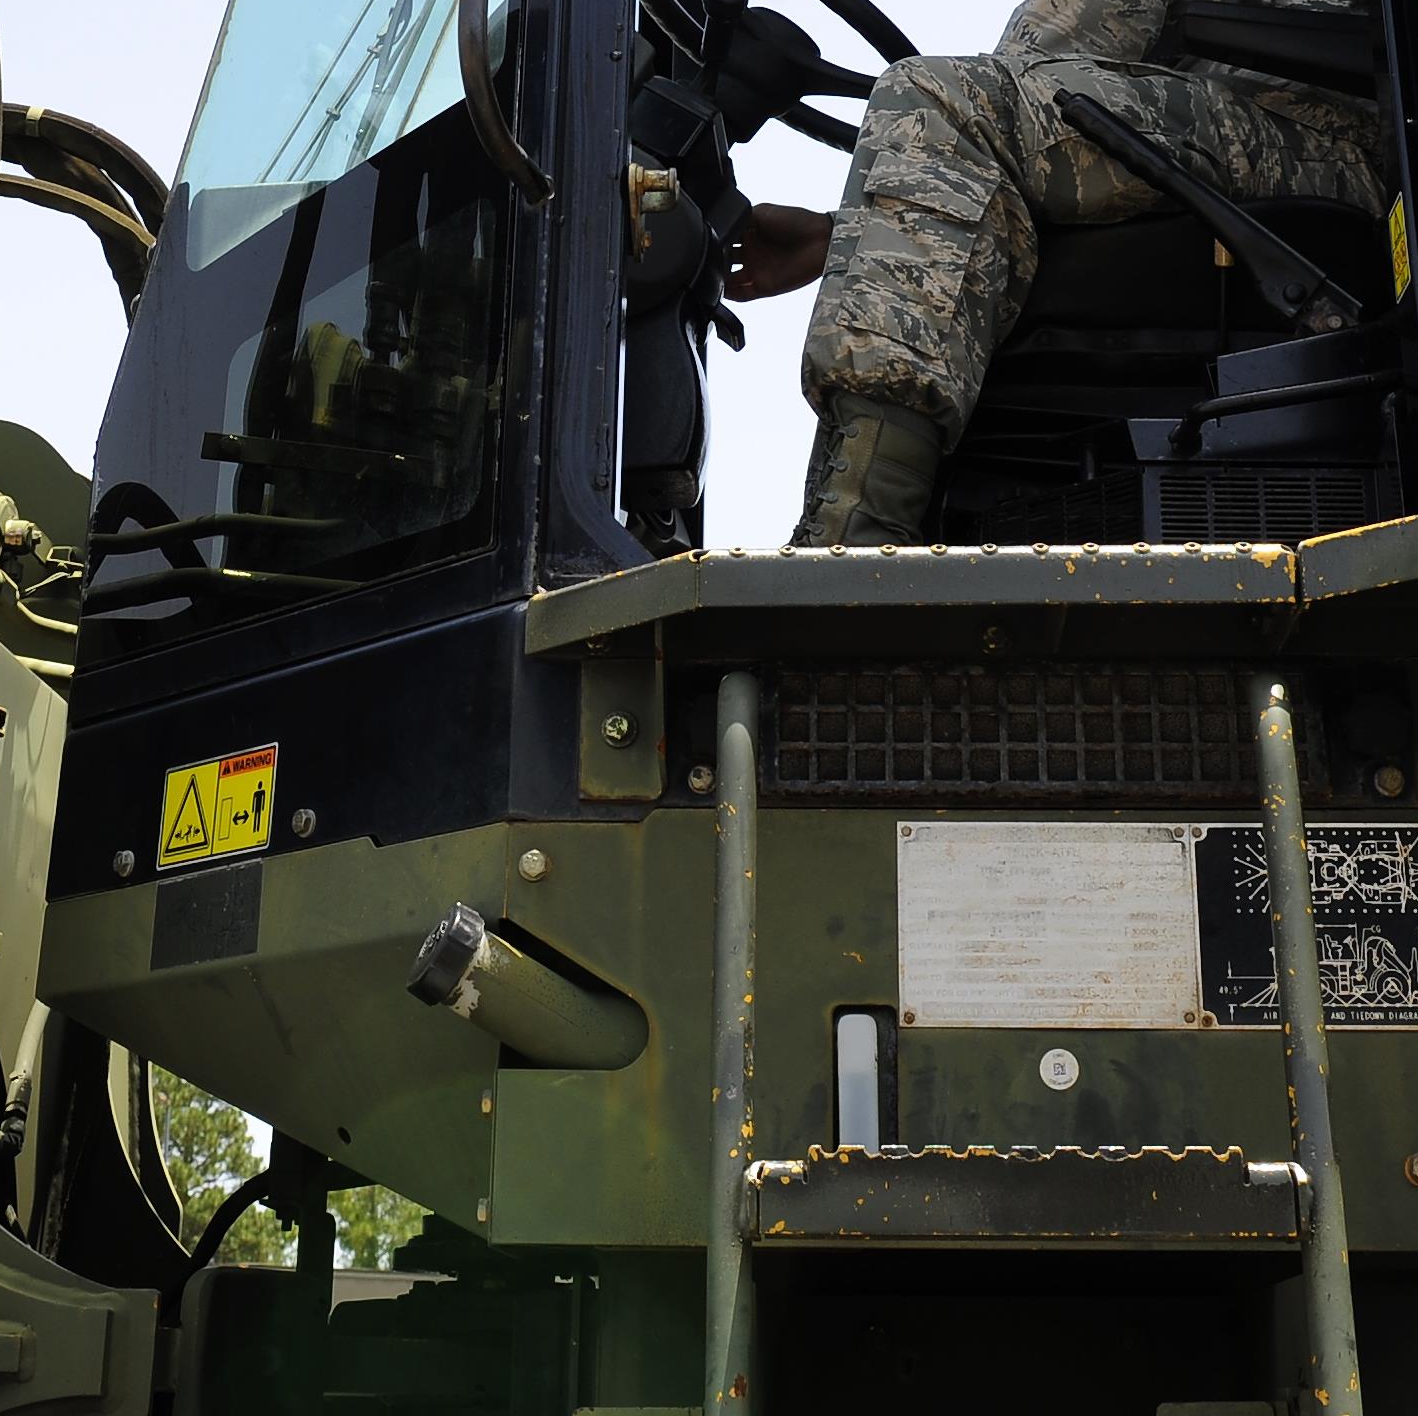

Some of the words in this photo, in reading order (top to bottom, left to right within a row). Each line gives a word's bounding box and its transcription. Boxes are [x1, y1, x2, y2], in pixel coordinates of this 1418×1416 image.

[232, 752, 272, 773] WARNING
[1263, 1010, 1278, 1021] AIR
[1331, 1010, 1345, 1021] AND
[1350, 1010, 1385, 1021] TIEDOWN
